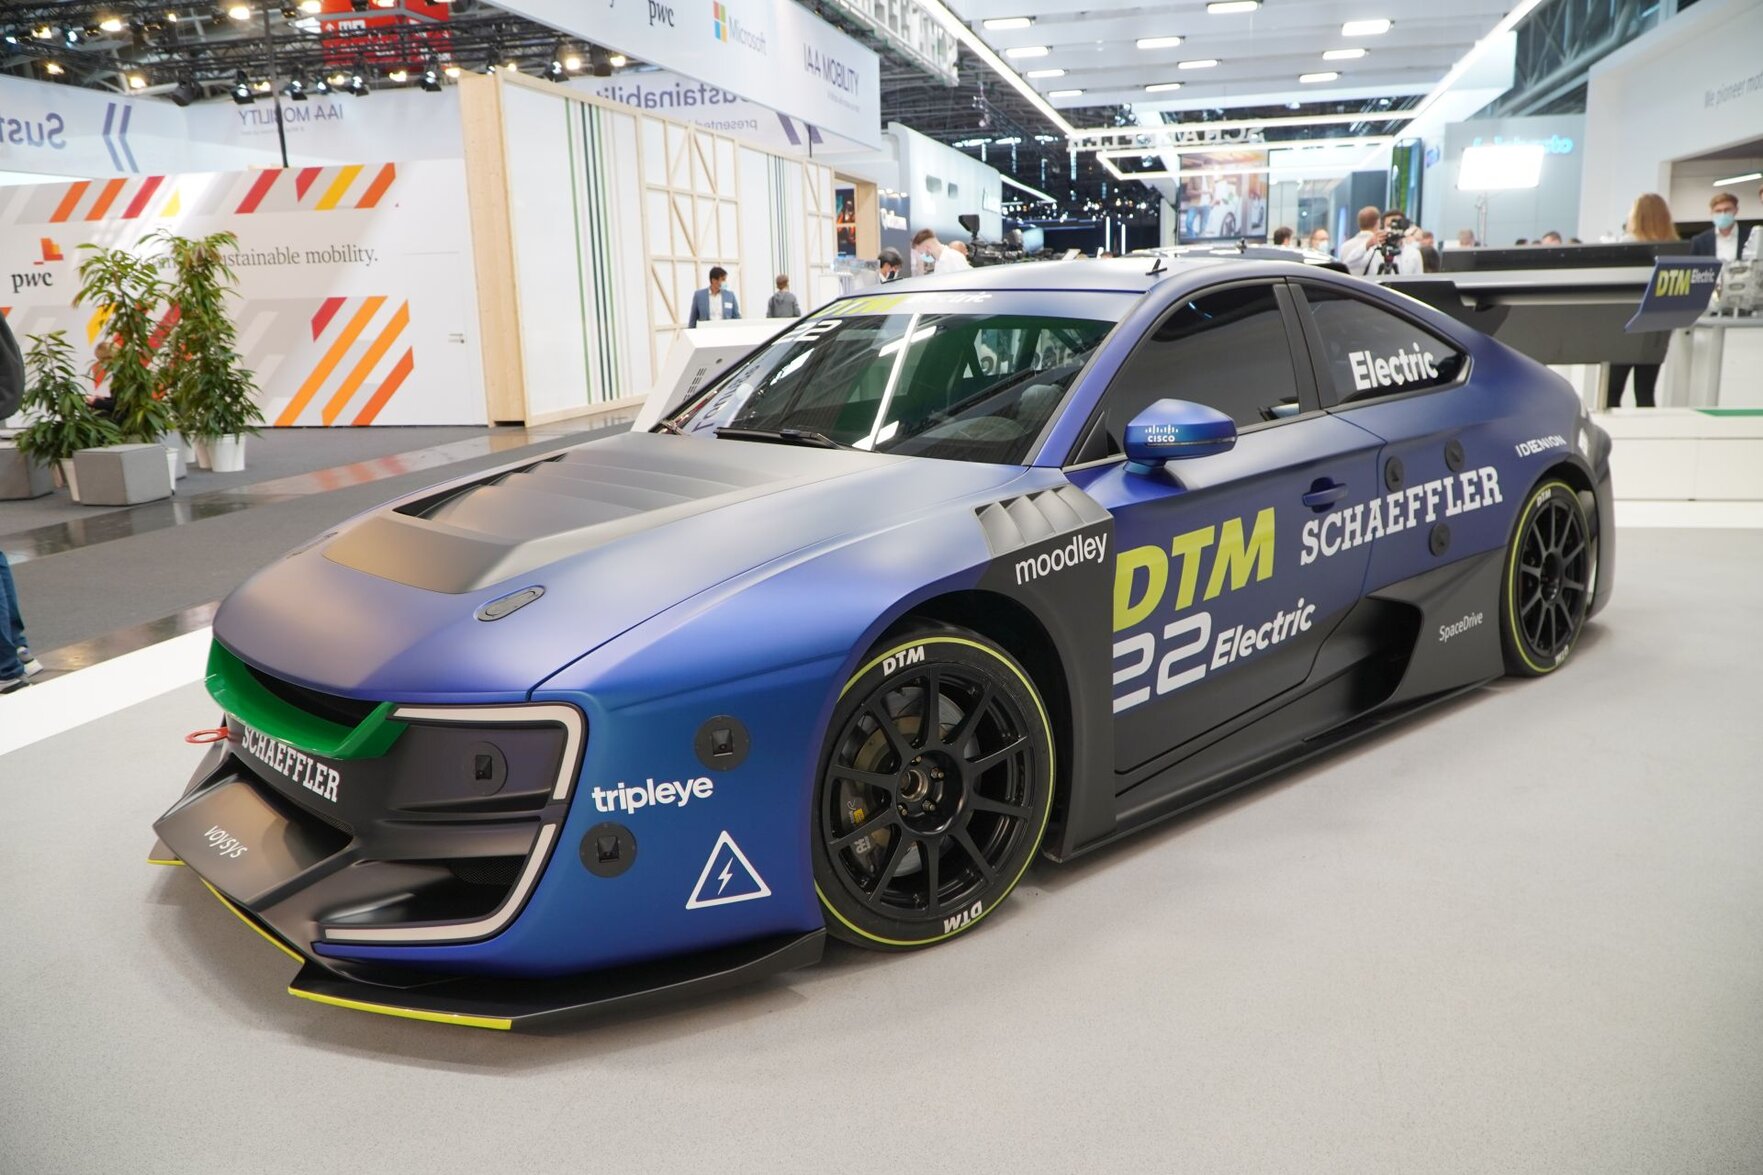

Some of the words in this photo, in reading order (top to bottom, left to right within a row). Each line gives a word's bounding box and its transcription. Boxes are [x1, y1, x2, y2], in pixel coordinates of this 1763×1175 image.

[648, 0, 675, 28] pwc
[728, 16, 767, 56] Microsoft
[803, 42, 821, 78] IAA
[821, 53, 860, 97] MOBILITY
[305, 243, 379, 267] mobility.
[10, 271, 54, 294] pwc
[1655, 268, 1692, 298] DTM
[1690, 266, 1716, 284] Electric
[1348, 342, 1439, 391] Electric
[1300, 465, 1503, 566] SCHAEFFLER
[1536, 488, 1552, 508] DTM
[1015, 532, 1107, 585] moodley
[1113, 506, 1275, 633] DTM
[1439, 611, 1483, 643] SpaceDrive
[882, 645, 925, 677] DTM
[1113, 611, 1212, 714] 22
[1210, 597, 1316, 670] Electric
[241, 725, 340, 803] SCHAEFFLER
[591, 777, 714, 815] tripleye
[203, 825, 248, 858] voysys
[943, 900, 983, 934] DTM
